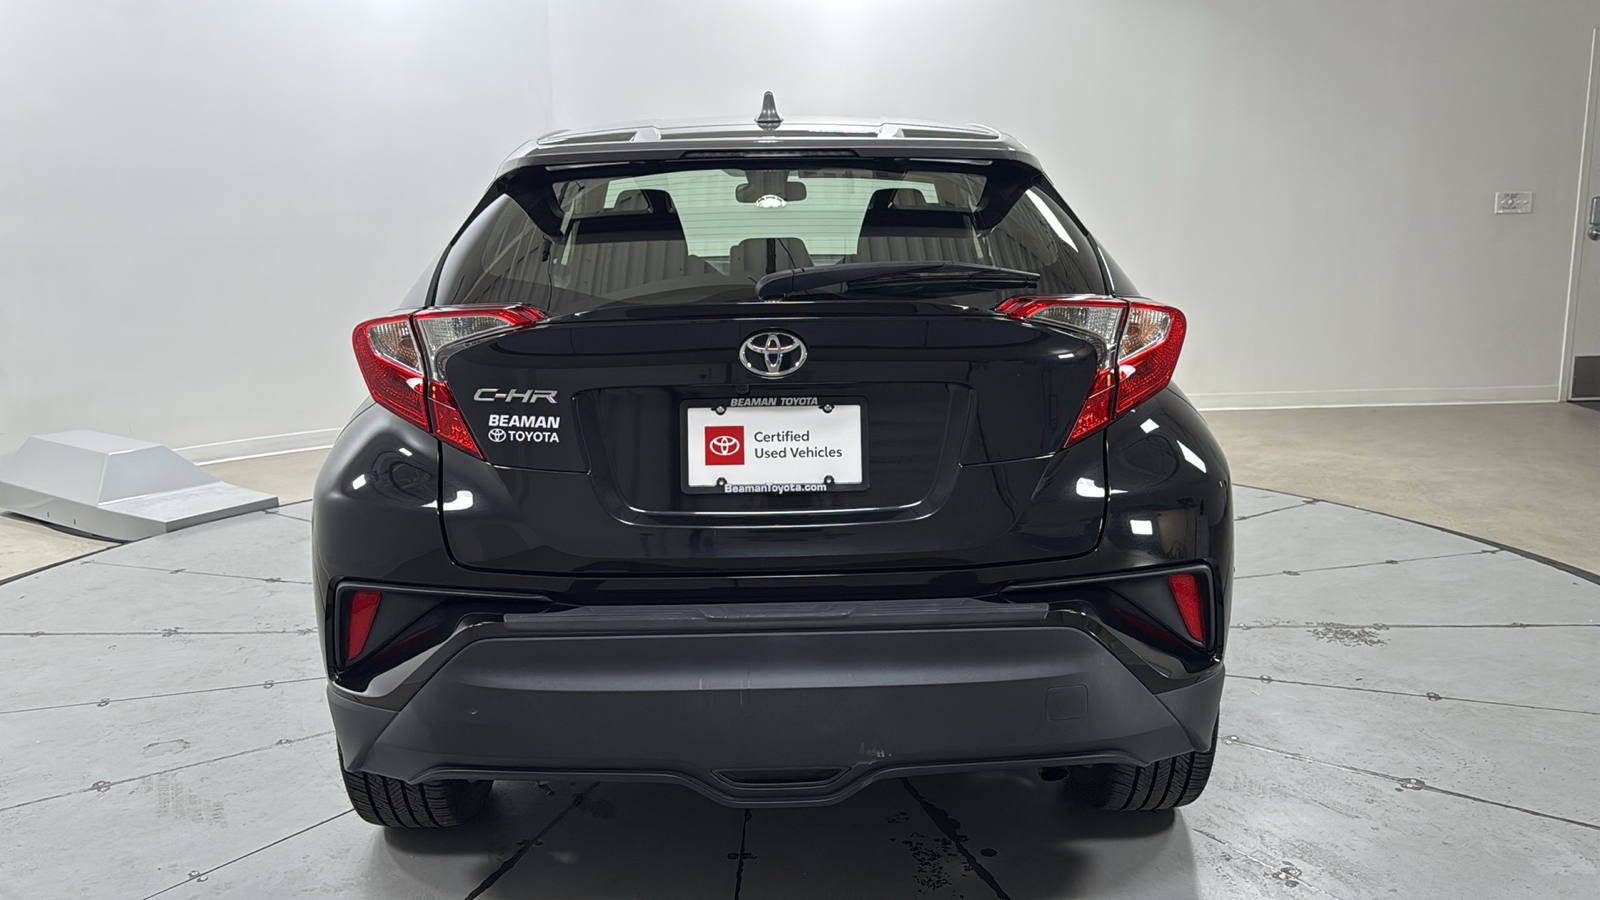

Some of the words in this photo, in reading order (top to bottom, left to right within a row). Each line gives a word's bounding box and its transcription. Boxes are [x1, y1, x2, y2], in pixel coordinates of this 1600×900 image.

[473, 388, 558, 403] C-HR
[730, 397, 777, 407] BEAMAN
[780, 396, 818, 406] TOYOTA
[488, 414, 560, 428] BEAMAN
[508, 431, 559, 442] TOYOTA
[754, 430, 810, 442] Certified
[754, 447, 787, 458] Used
[790, 446, 843, 458] Vehicles
[724, 483, 827, 494] BeamanToyota.com
